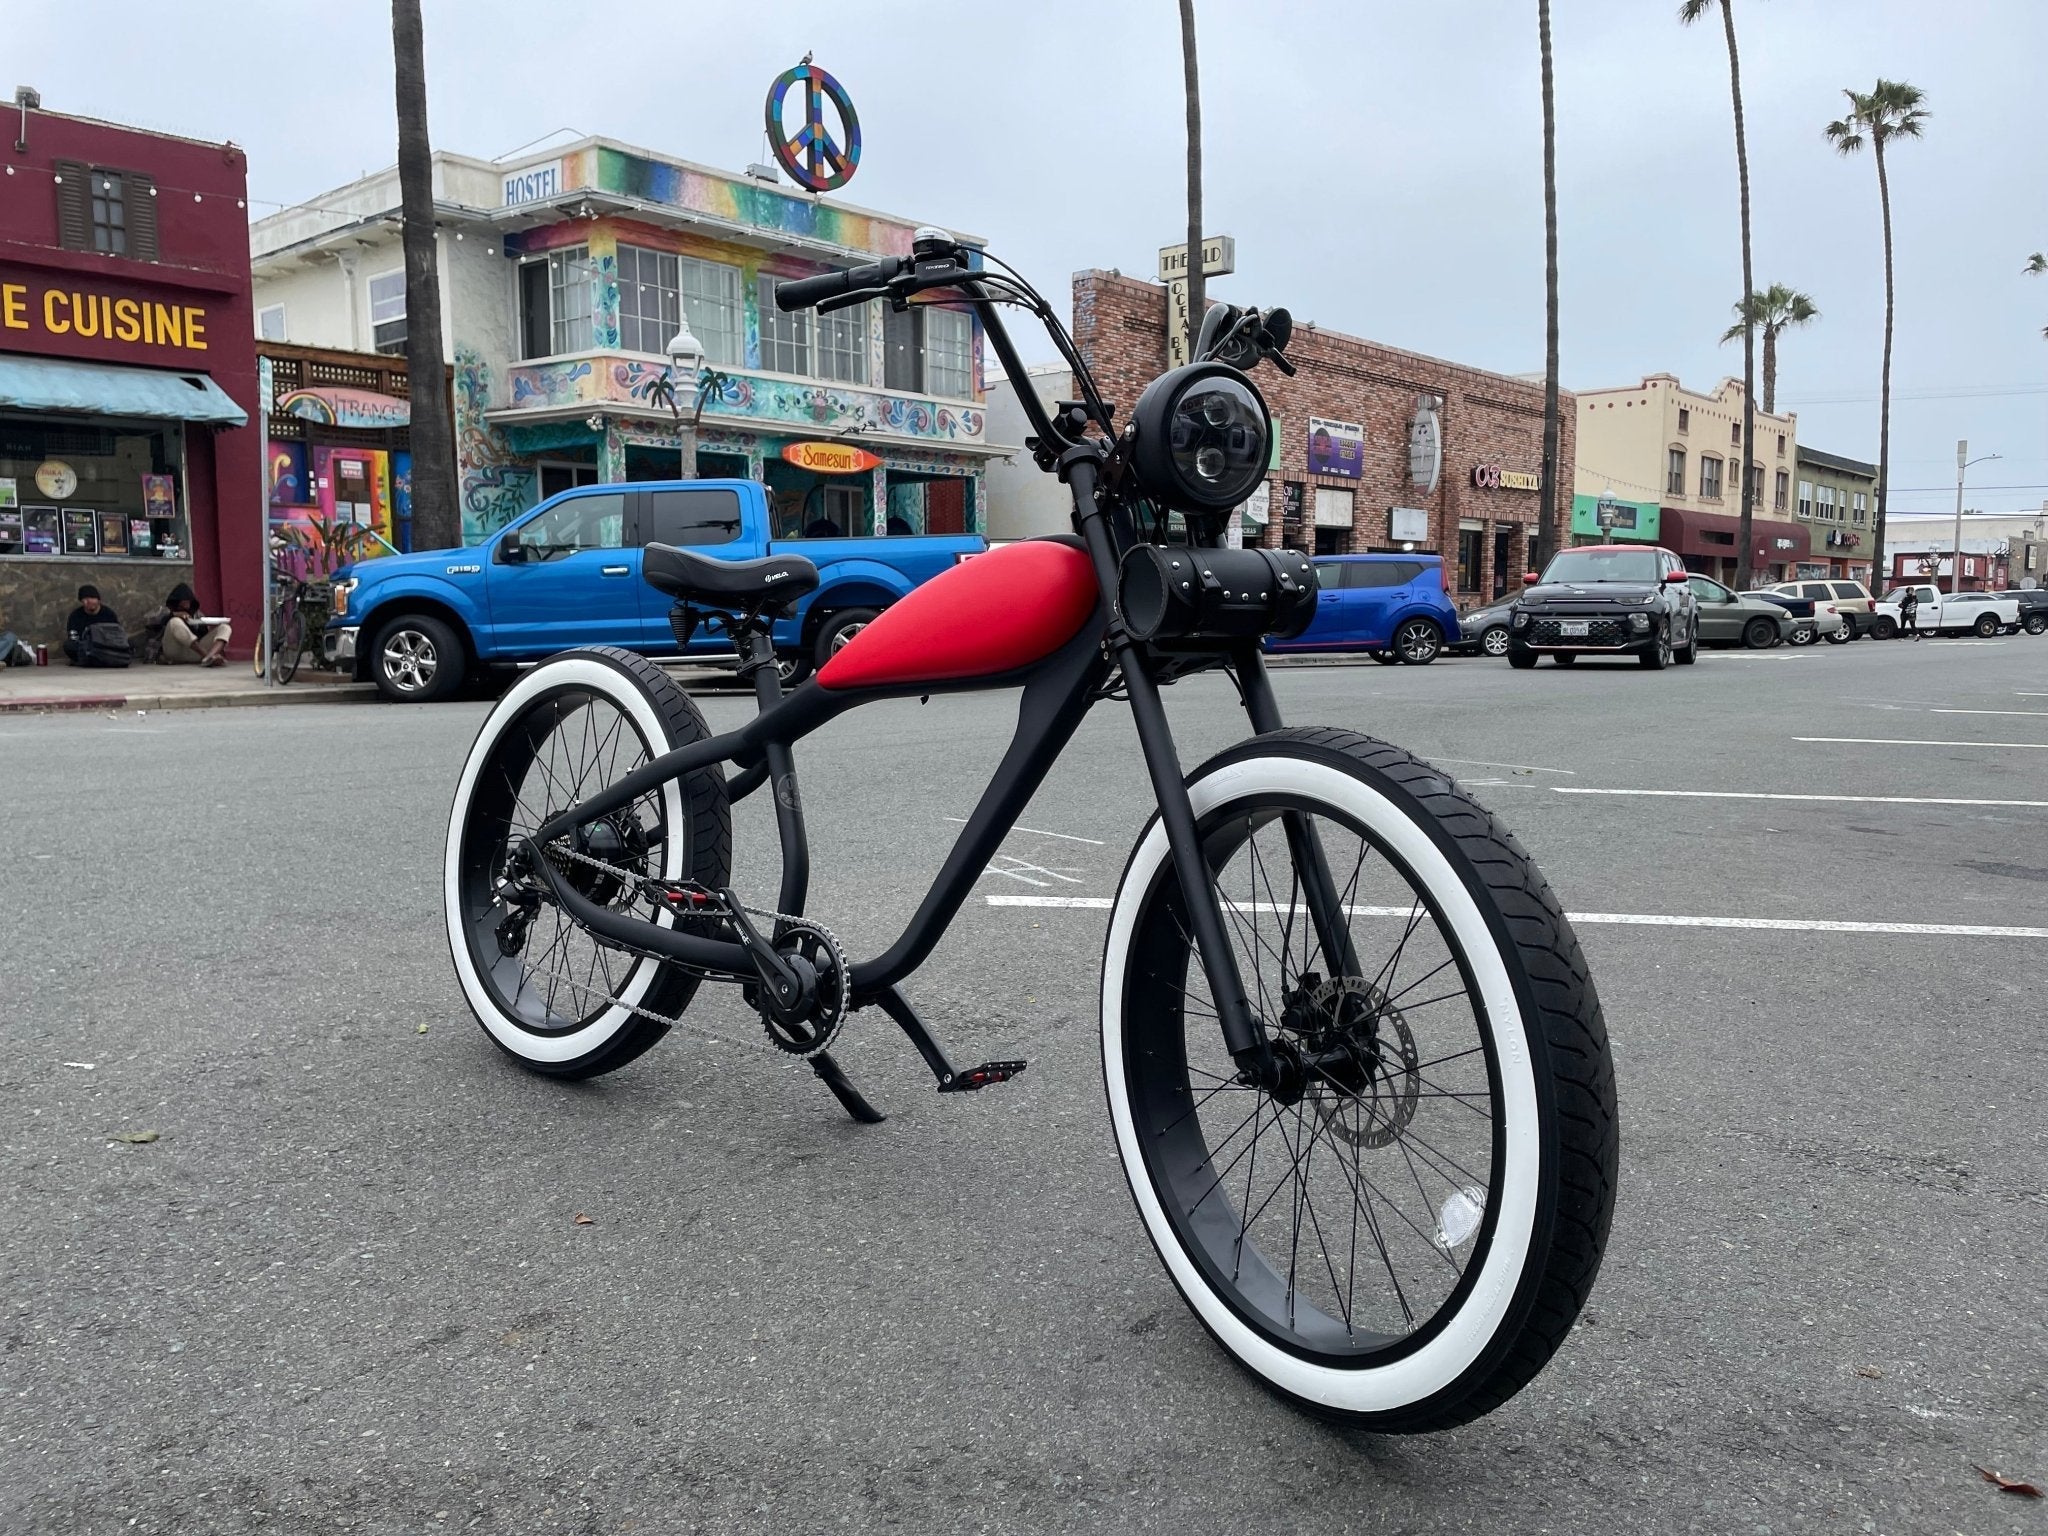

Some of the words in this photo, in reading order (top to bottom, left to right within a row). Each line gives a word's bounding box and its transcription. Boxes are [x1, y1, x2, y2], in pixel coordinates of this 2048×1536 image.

[506, 168, 559, 207] HOSTEL
[1162, 252, 1188, 271] THE
[1203, 247, 1222, 264] LD
[3, 283, 29, 330] E
[44, 289, 208, 350] CUISINE
[803, 444, 851, 470] Samesun
